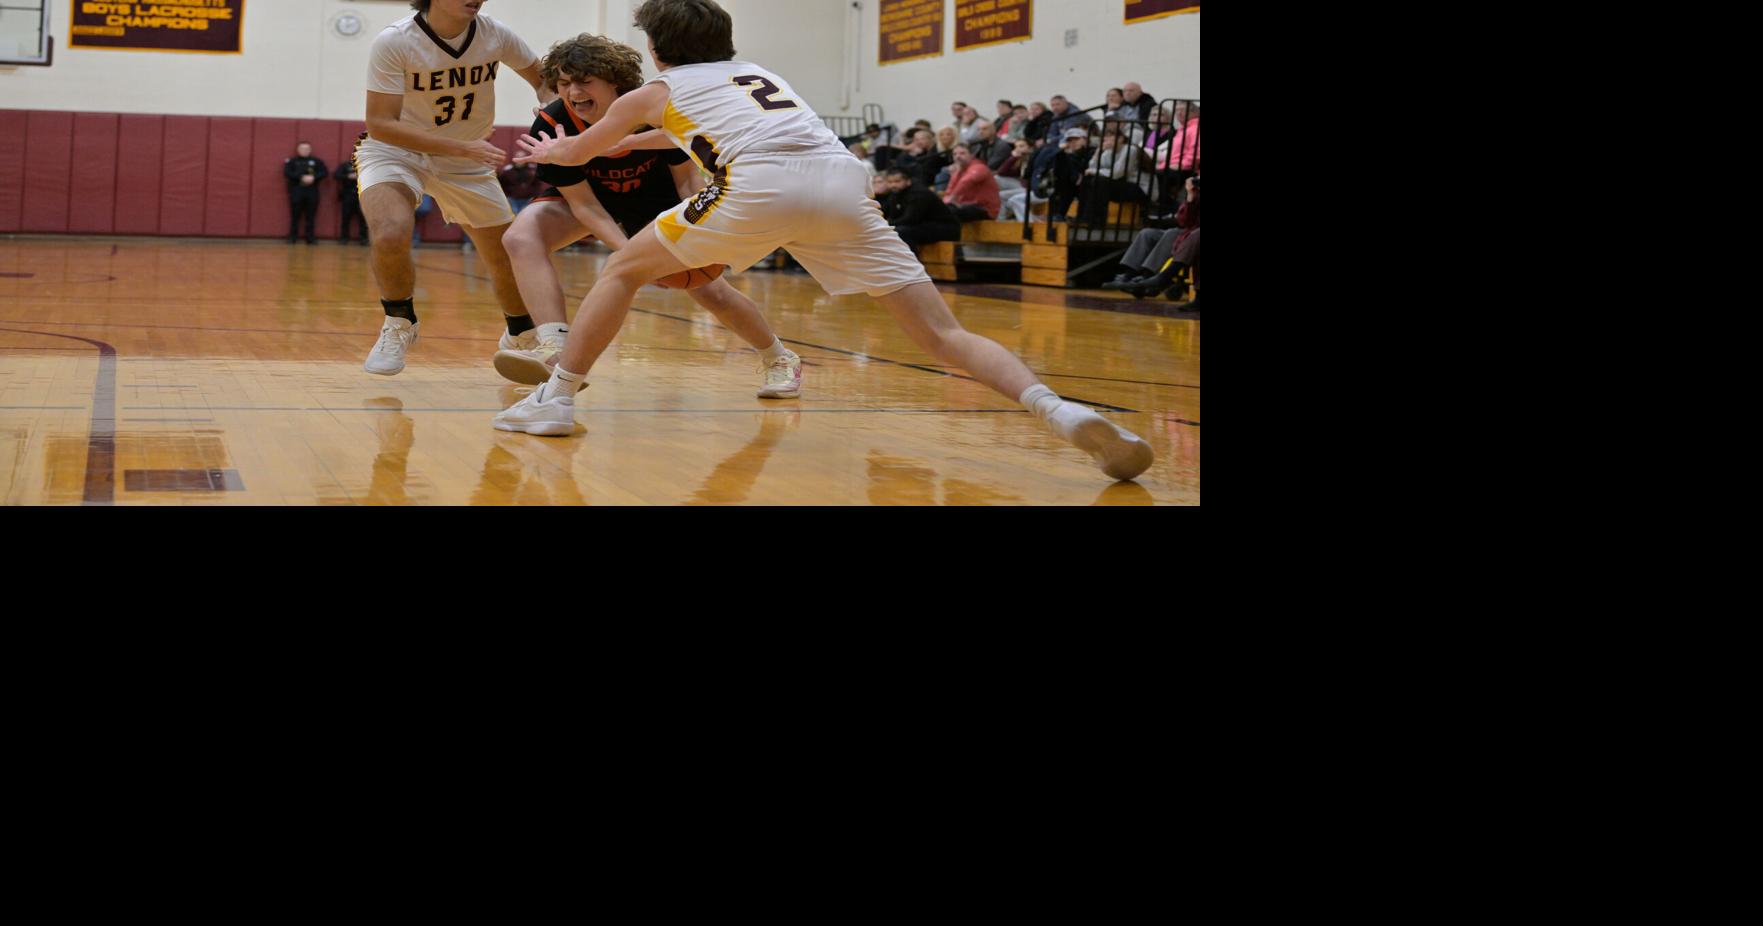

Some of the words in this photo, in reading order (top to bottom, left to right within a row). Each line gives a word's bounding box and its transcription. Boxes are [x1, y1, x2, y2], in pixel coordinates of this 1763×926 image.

[82, 2, 131, 15] BOYS
[136, 5, 233, 19] LACROSSE
[106, 15, 209, 30] CHAMPIONS
[964, 9, 1019, 31] CHAMPIONS
[412, 61, 498, 92] LENOX
[731, 75, 800, 111] 2
[434, 92, 475, 127] 31
